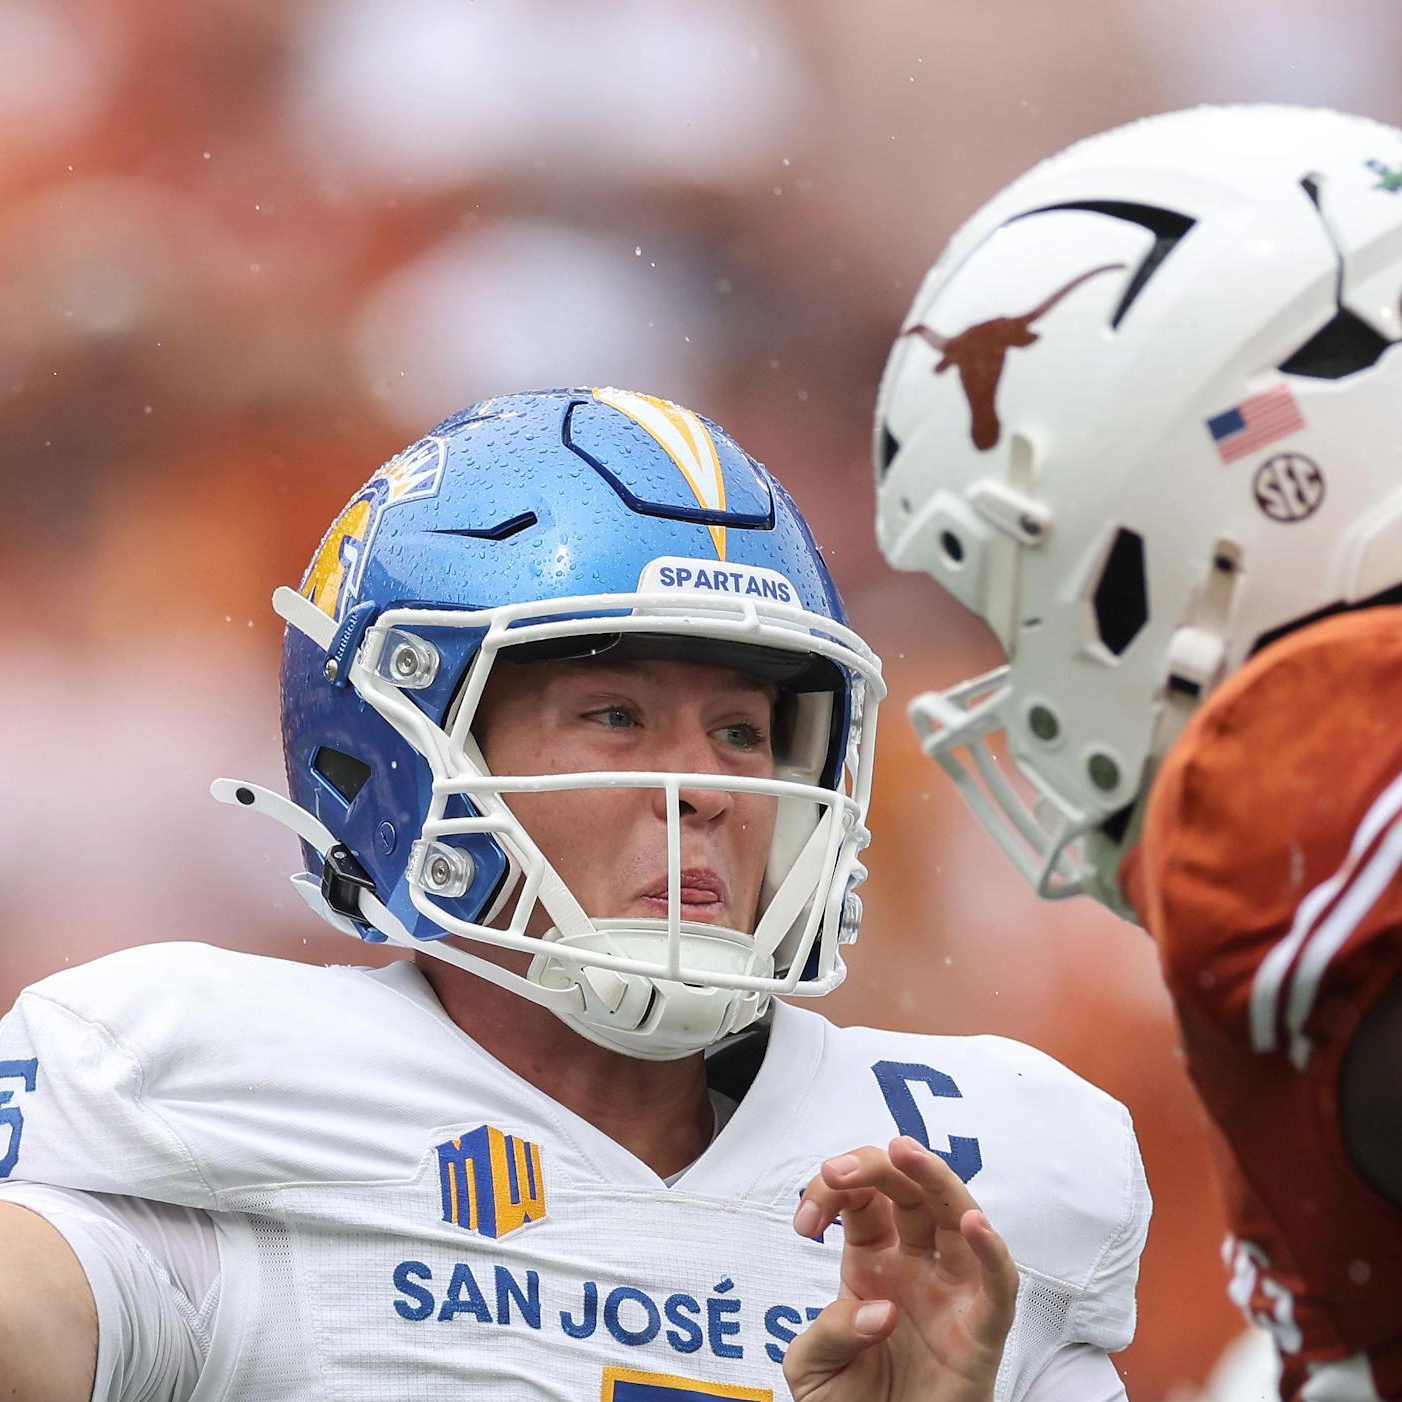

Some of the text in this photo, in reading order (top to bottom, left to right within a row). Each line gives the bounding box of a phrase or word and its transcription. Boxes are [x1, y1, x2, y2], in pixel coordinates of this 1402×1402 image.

[659, 566, 791, 603] SPARTANS
[392, 1260, 542, 1330] SAN
[558, 1274, 744, 1360] JOSÉ
